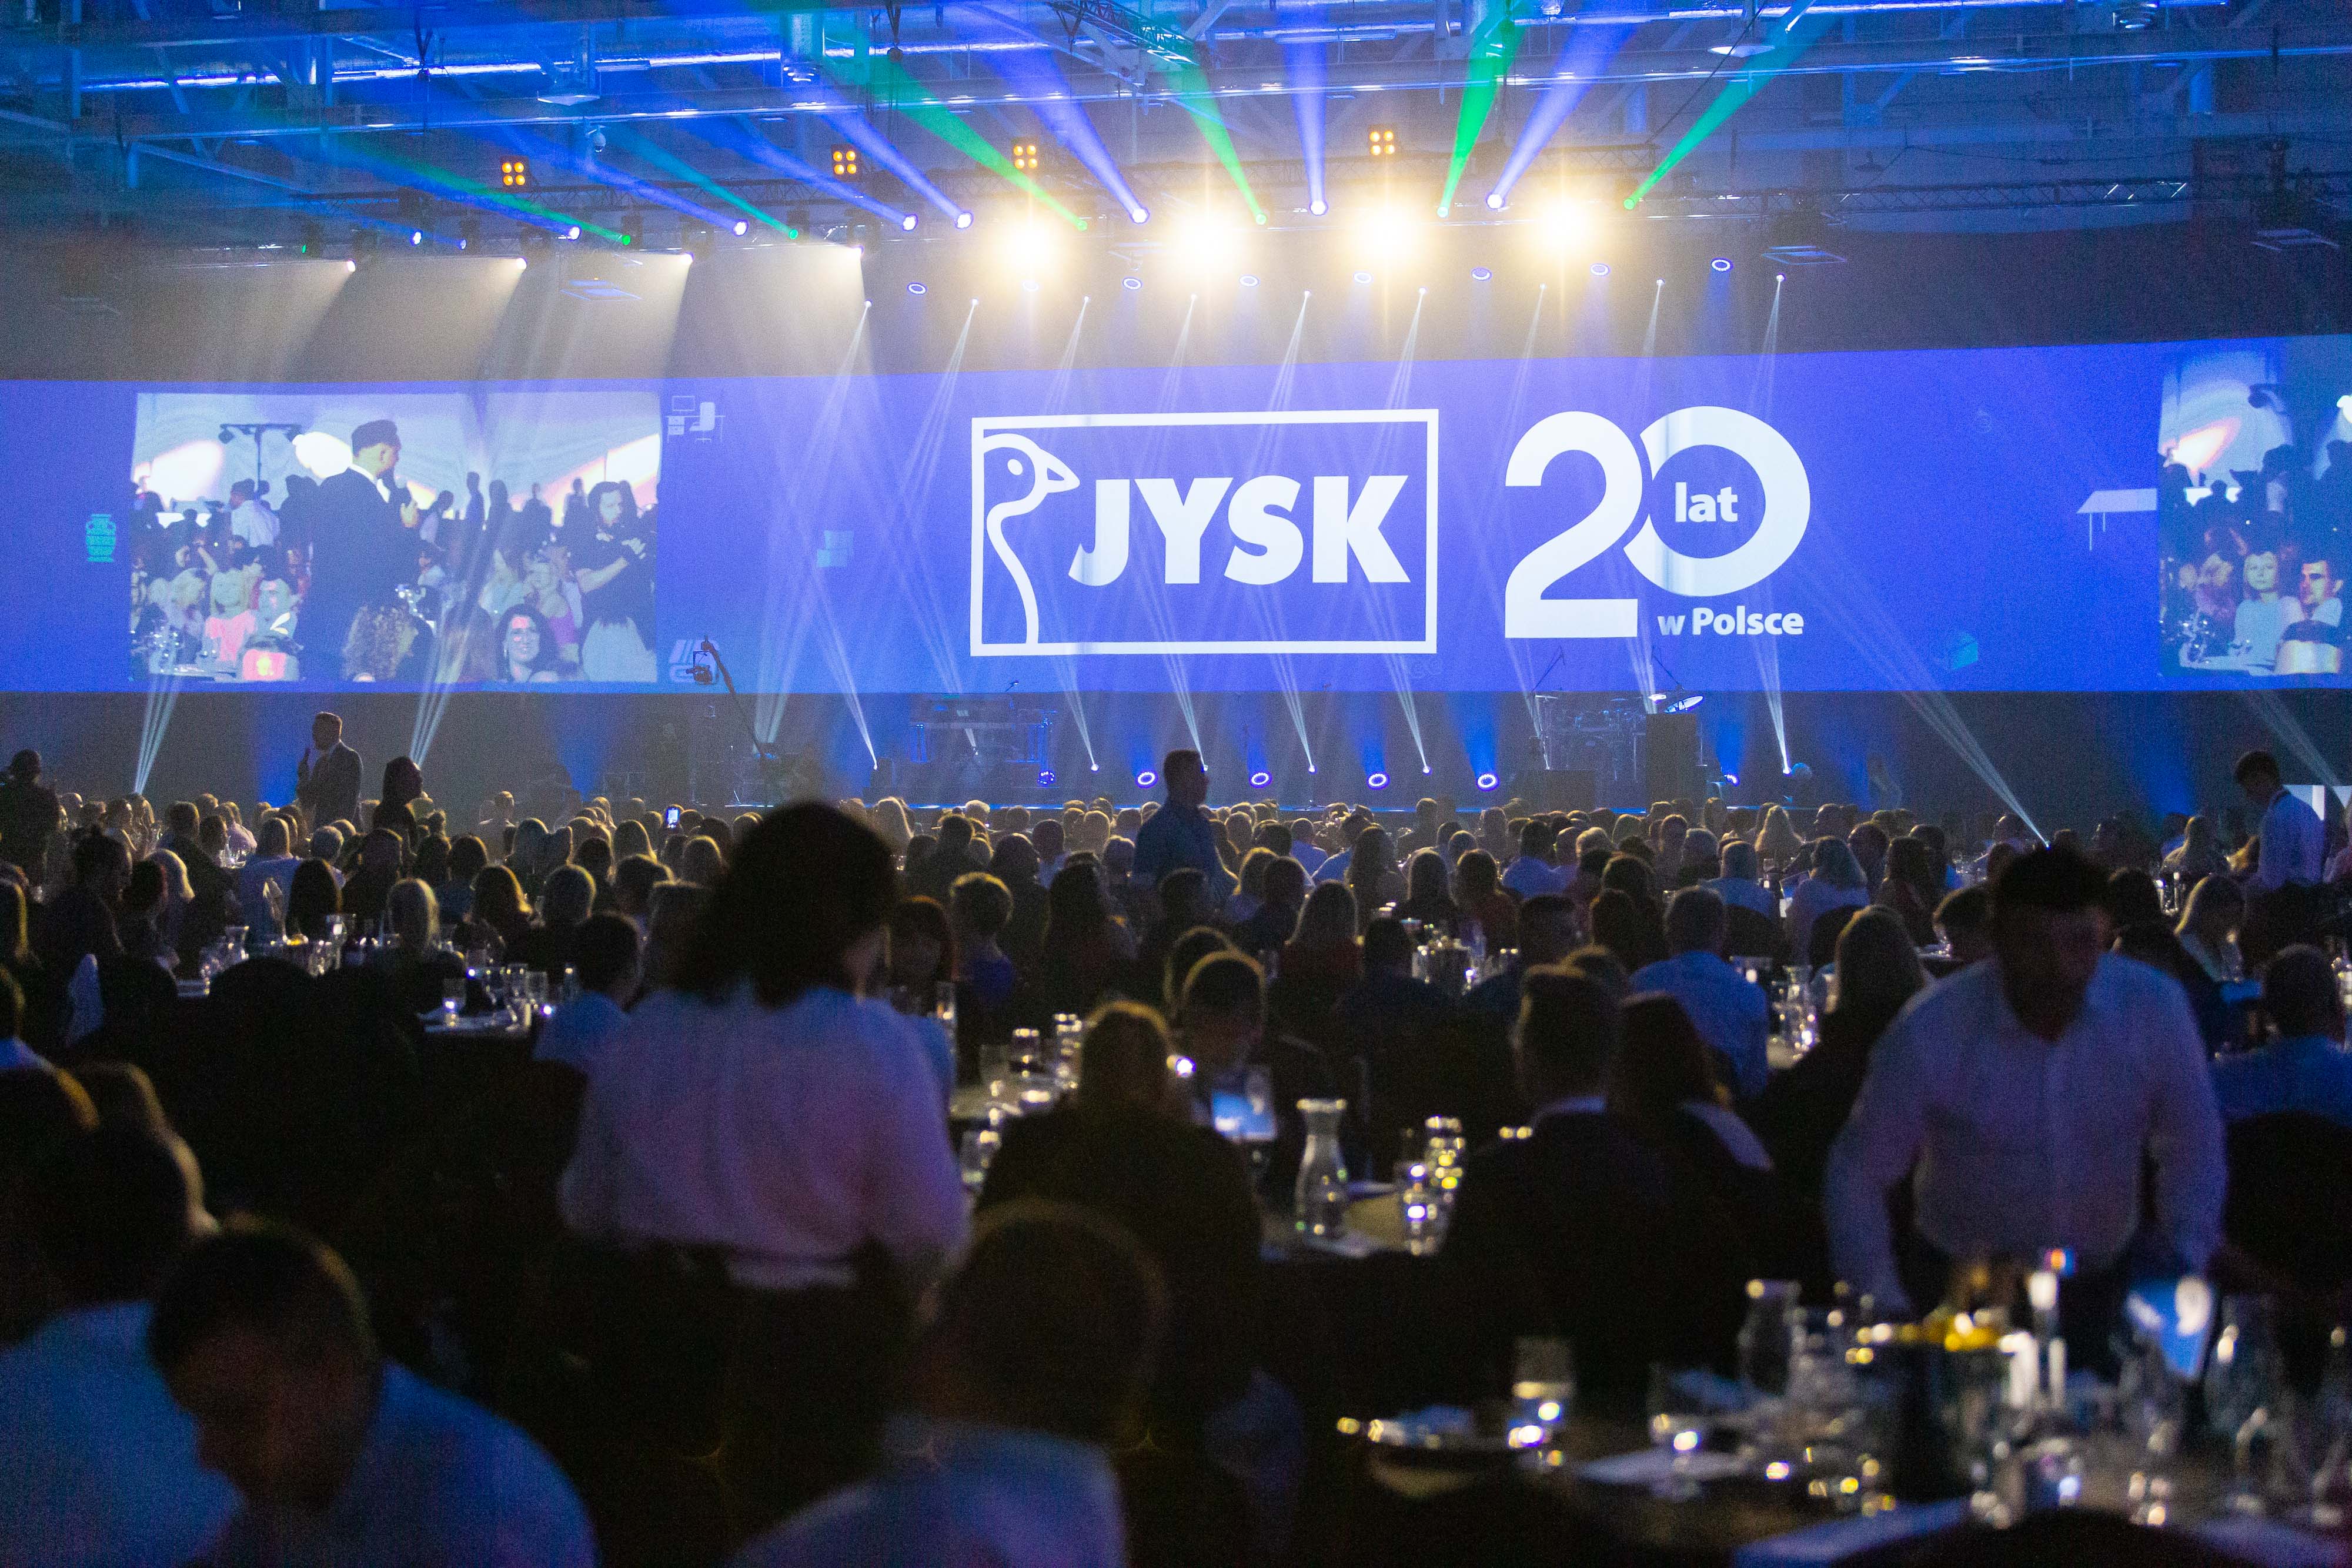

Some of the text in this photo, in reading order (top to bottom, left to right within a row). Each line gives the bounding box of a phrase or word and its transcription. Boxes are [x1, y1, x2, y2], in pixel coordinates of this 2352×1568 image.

[1068, 476, 1411, 586] JYSK
[1505, 406, 1810, 638] 20
[1675, 482, 1738, 523] lat
[1658, 606, 1804, 636] w Polsce
